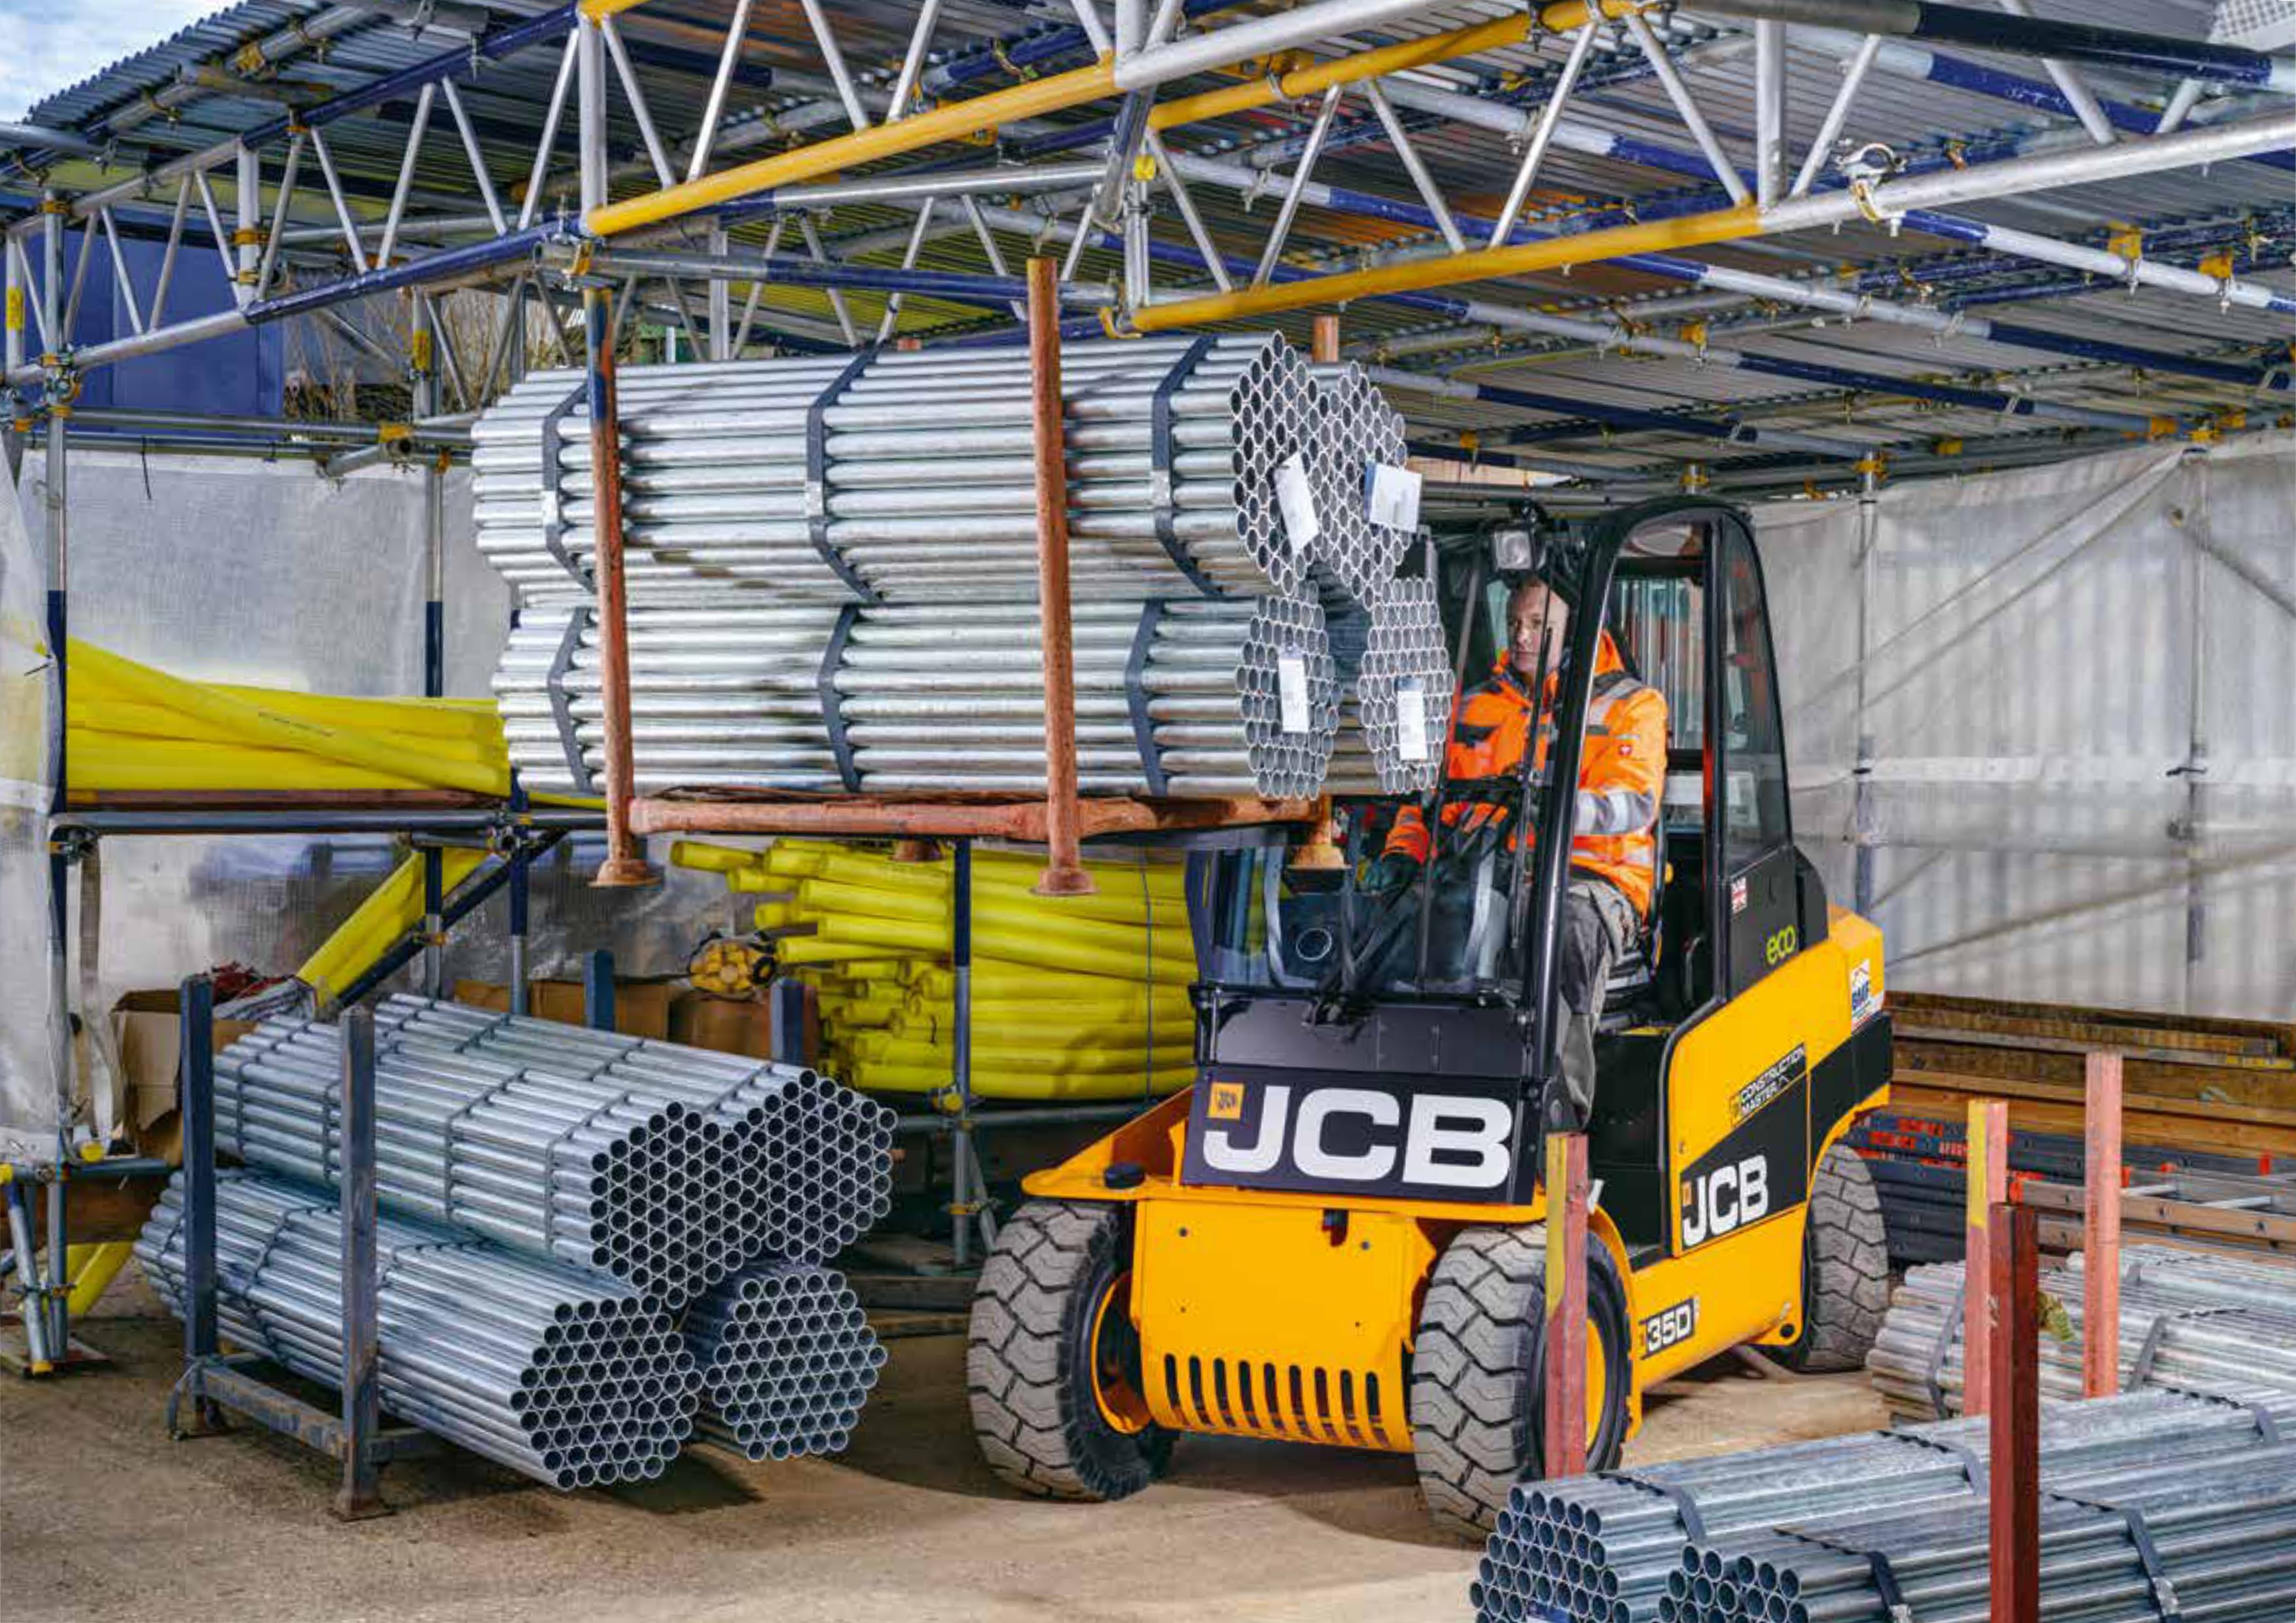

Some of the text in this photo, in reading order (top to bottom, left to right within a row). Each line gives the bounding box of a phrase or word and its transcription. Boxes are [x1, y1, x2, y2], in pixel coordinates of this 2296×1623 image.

[1767, 925, 1795, 965] eco
[1740, 1047, 1804, 1103] CONSTRUCTION
[1742, 1080, 1779, 1115] MASTER
[1203, 1085, 1513, 1188] JCB
[1683, 1155, 1768, 1247] JCB
[1647, 1304, 1692, 1352] 35D
